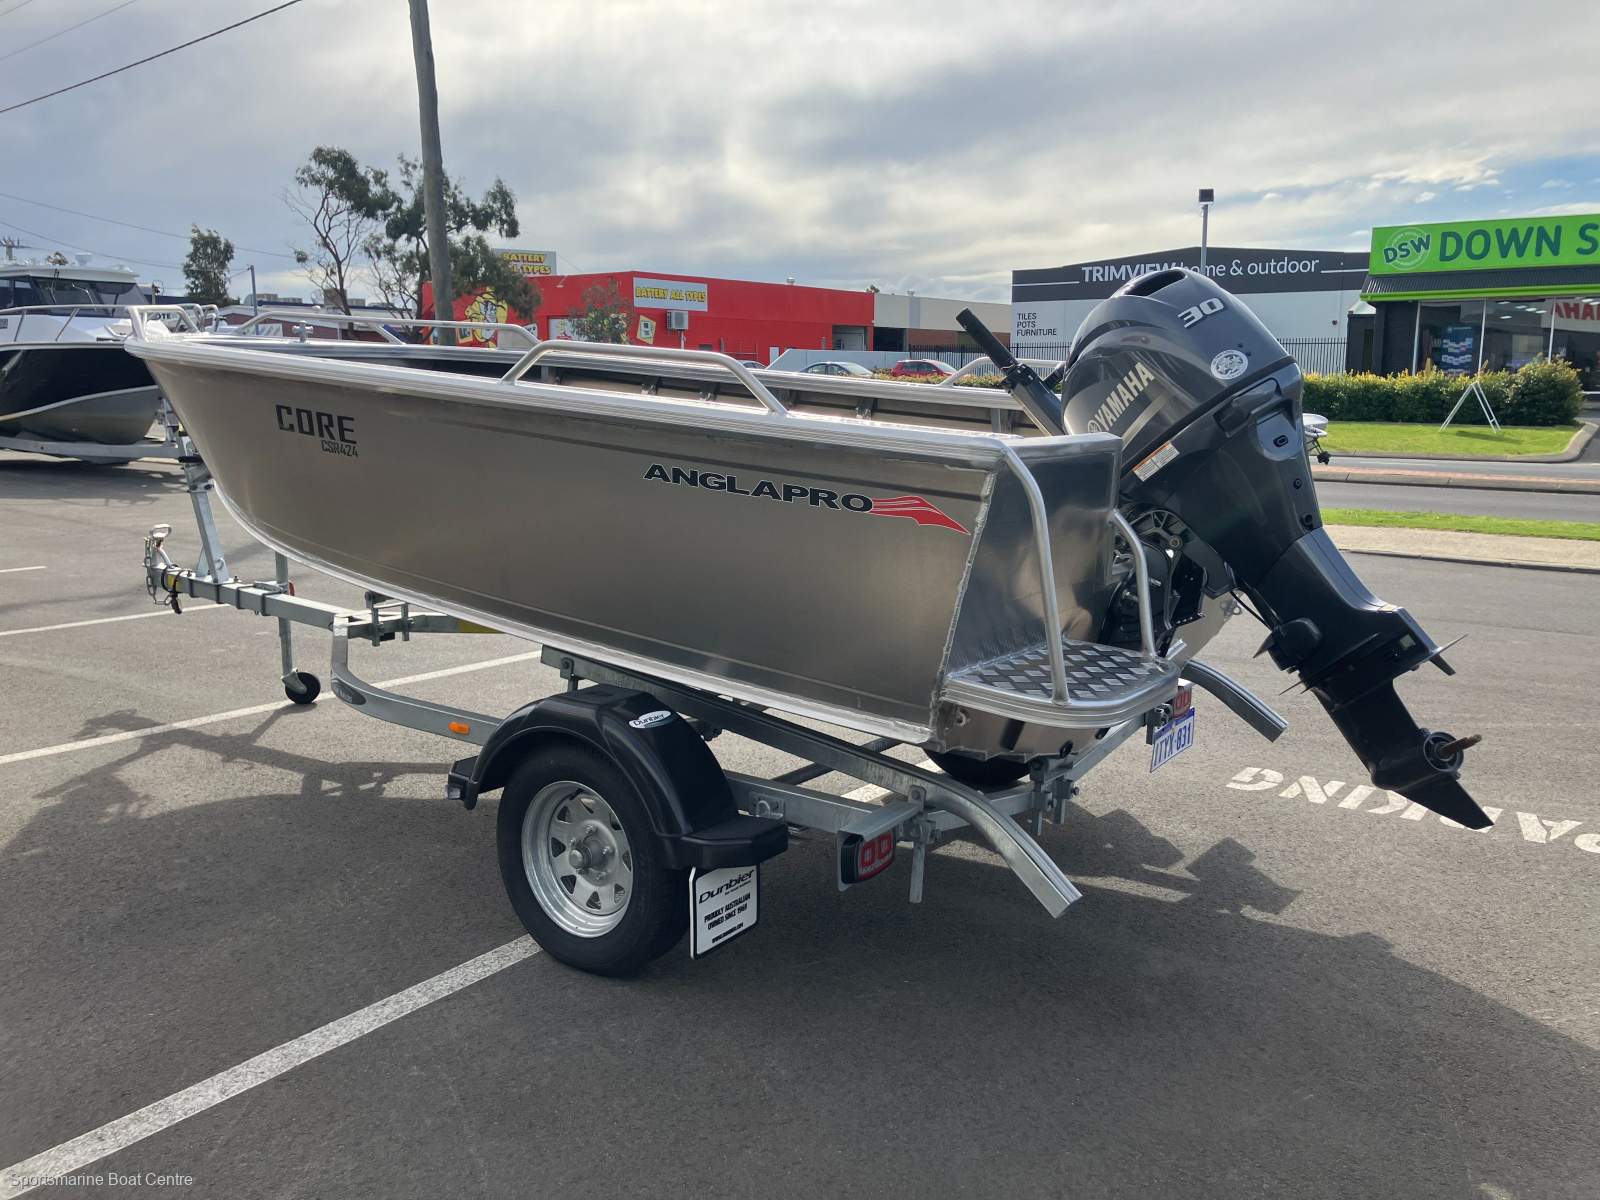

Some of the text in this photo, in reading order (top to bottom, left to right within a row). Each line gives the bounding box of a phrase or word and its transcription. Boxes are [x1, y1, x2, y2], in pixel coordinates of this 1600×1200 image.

[1383, 234, 1431, 264] DSW
[1438, 224, 1562, 262] DOWN
[522, 264, 552, 275] TYPES
[1230, 259, 1244, 276] &
[1250, 256, 1319, 276] outdoor
[636, 287, 706, 303] BATTERY ALL TYPES
[1017, 312, 1037, 321] TILES
[1177, 297, 1225, 330] 30
[1016, 320, 1036, 329] POTS
[1016, 328, 1057, 337] FURNITURE
[1094, 361, 1156, 432] YAMAHA
[275, 404, 357, 444] CORE
[321, 439, 359, 458] CSR424
[643, 463, 874, 513] ANGLAPRO
[633, 714, 665, 726] Dunbier
[699, 869, 755, 904] Dunbier
